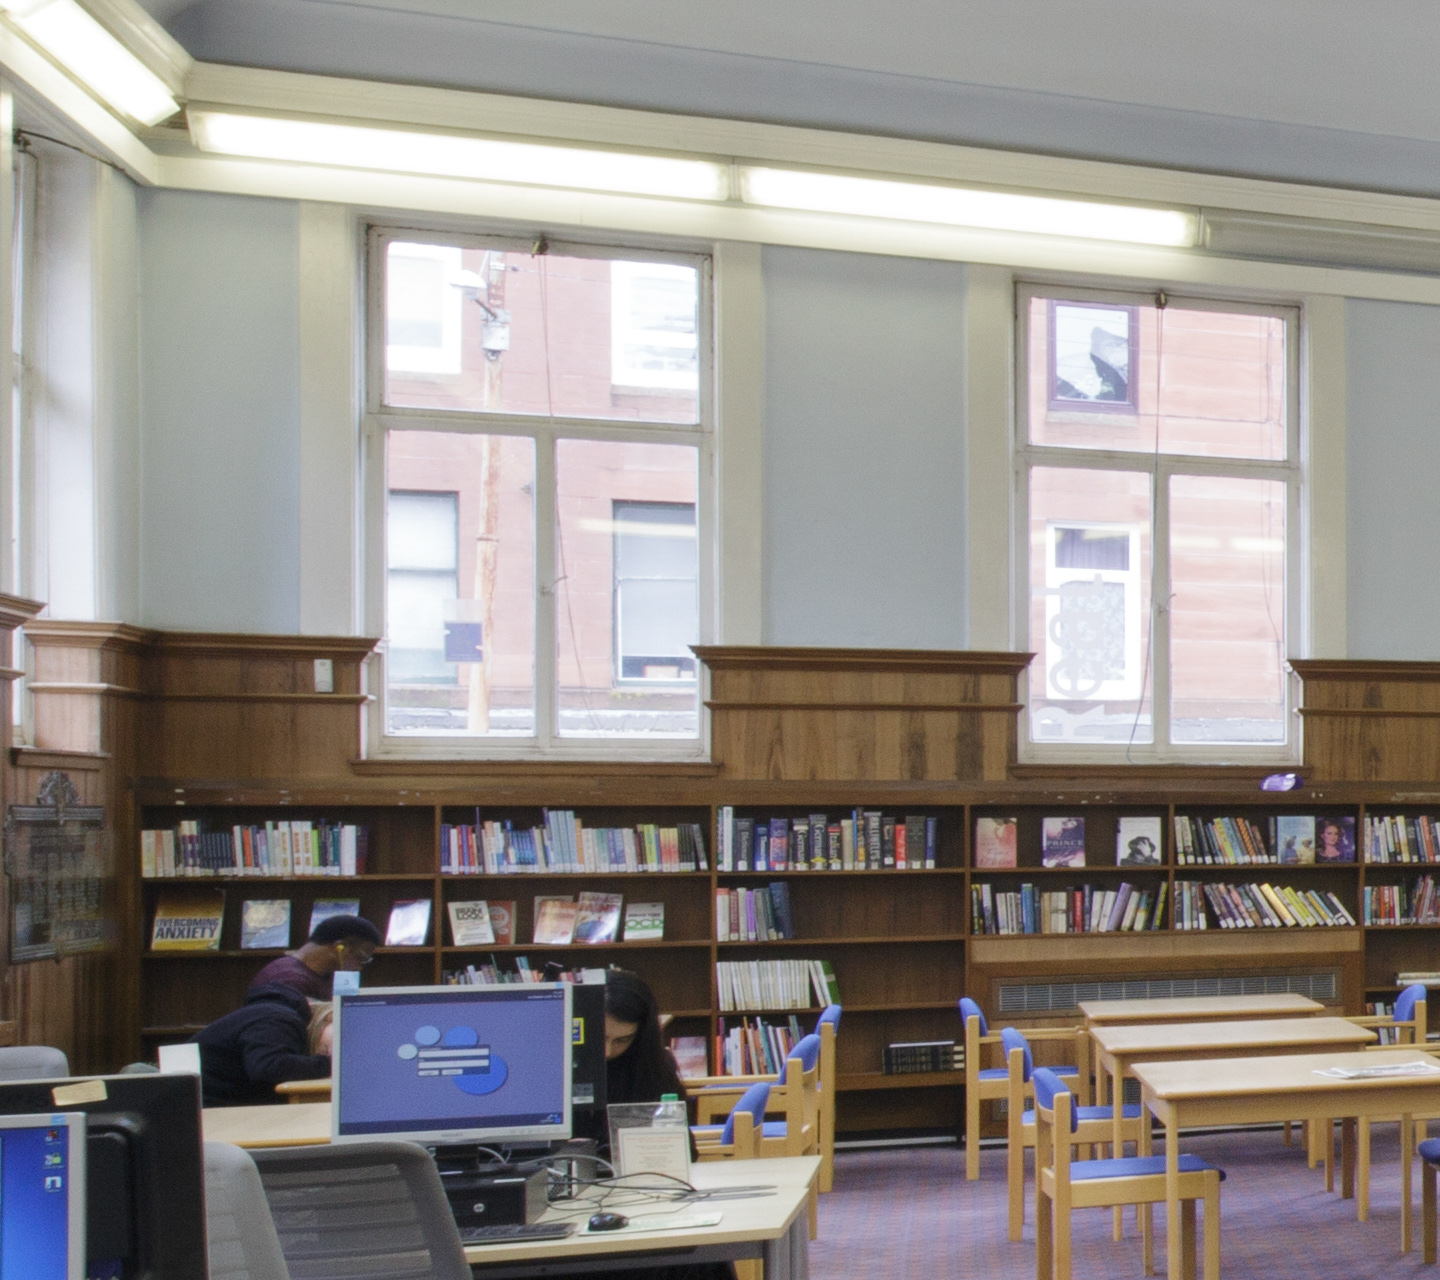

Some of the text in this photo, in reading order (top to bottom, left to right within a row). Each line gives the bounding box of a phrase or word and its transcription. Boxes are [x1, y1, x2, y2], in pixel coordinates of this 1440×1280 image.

[1046, 839, 1084, 847] PRINCE
[155, 917, 218, 927] OVERCOMING
[155, 926, 217, 939] ANXIETY
